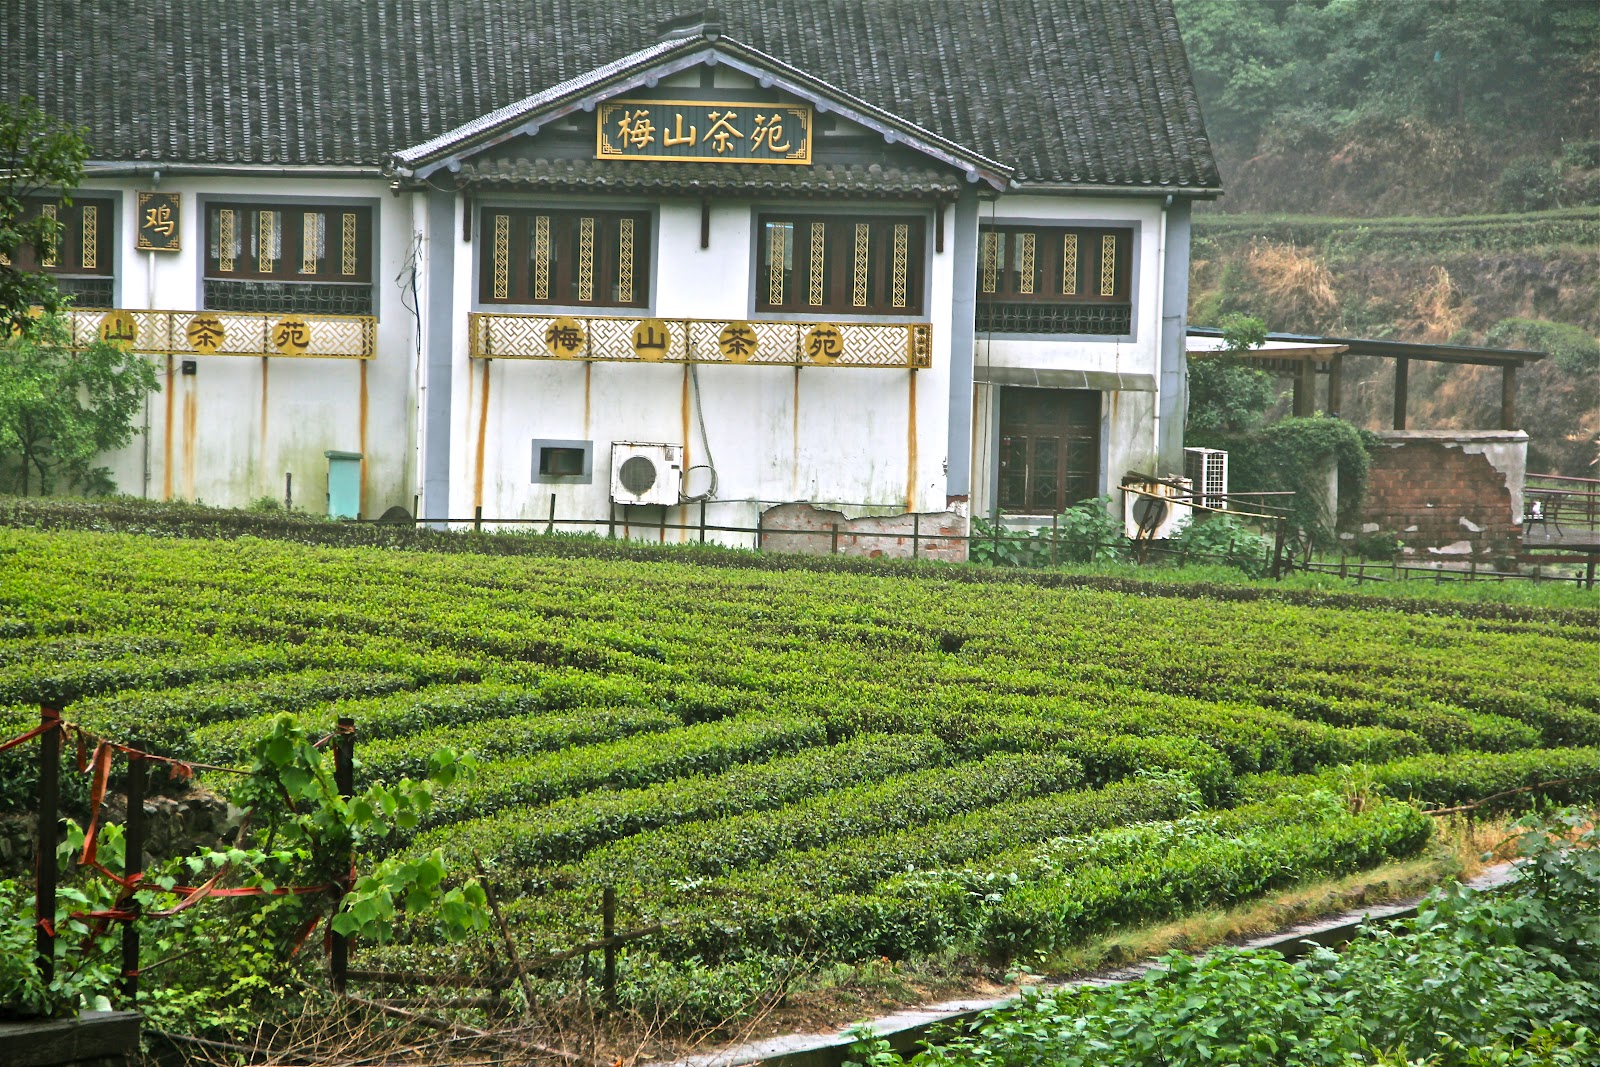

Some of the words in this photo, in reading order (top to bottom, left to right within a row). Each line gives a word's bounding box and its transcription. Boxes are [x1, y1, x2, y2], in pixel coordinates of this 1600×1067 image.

[616, 109, 791, 154] 梅山茶苑
[142, 204, 175, 237] 鸡
[13, 318, 310, 349] 山茶苑
[546, 325, 842, 358] 梅山茶苑
